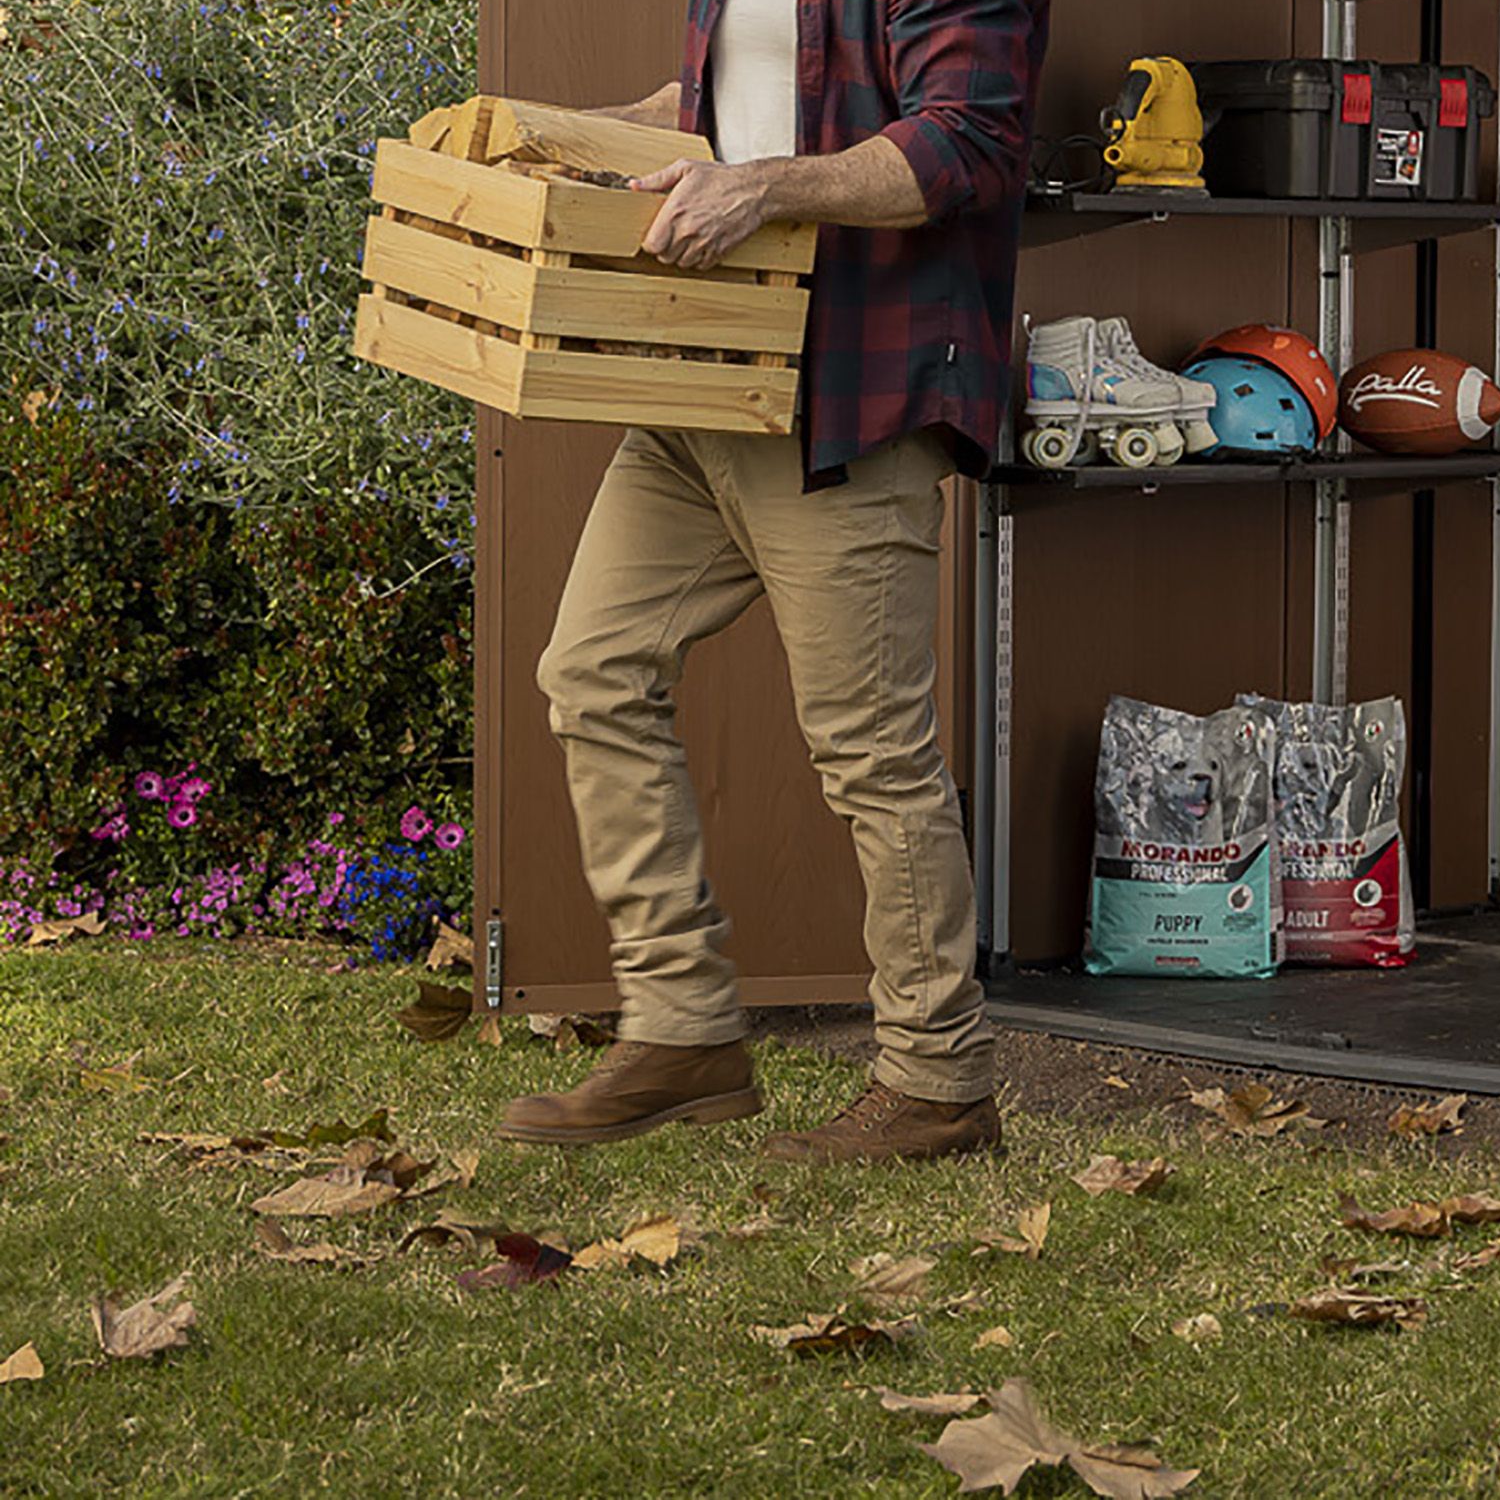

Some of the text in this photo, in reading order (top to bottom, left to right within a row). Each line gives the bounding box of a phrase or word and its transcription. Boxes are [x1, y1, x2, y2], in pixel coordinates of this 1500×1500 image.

[1347, 365, 1442, 405] palla
[1121, 840, 1241, 863] MORANDO
[1131, 863, 1228, 883] PROFESSIONAL
[1154, 914, 1203, 932] PUPPY
[1286, 910, 1329, 928] ADULT
